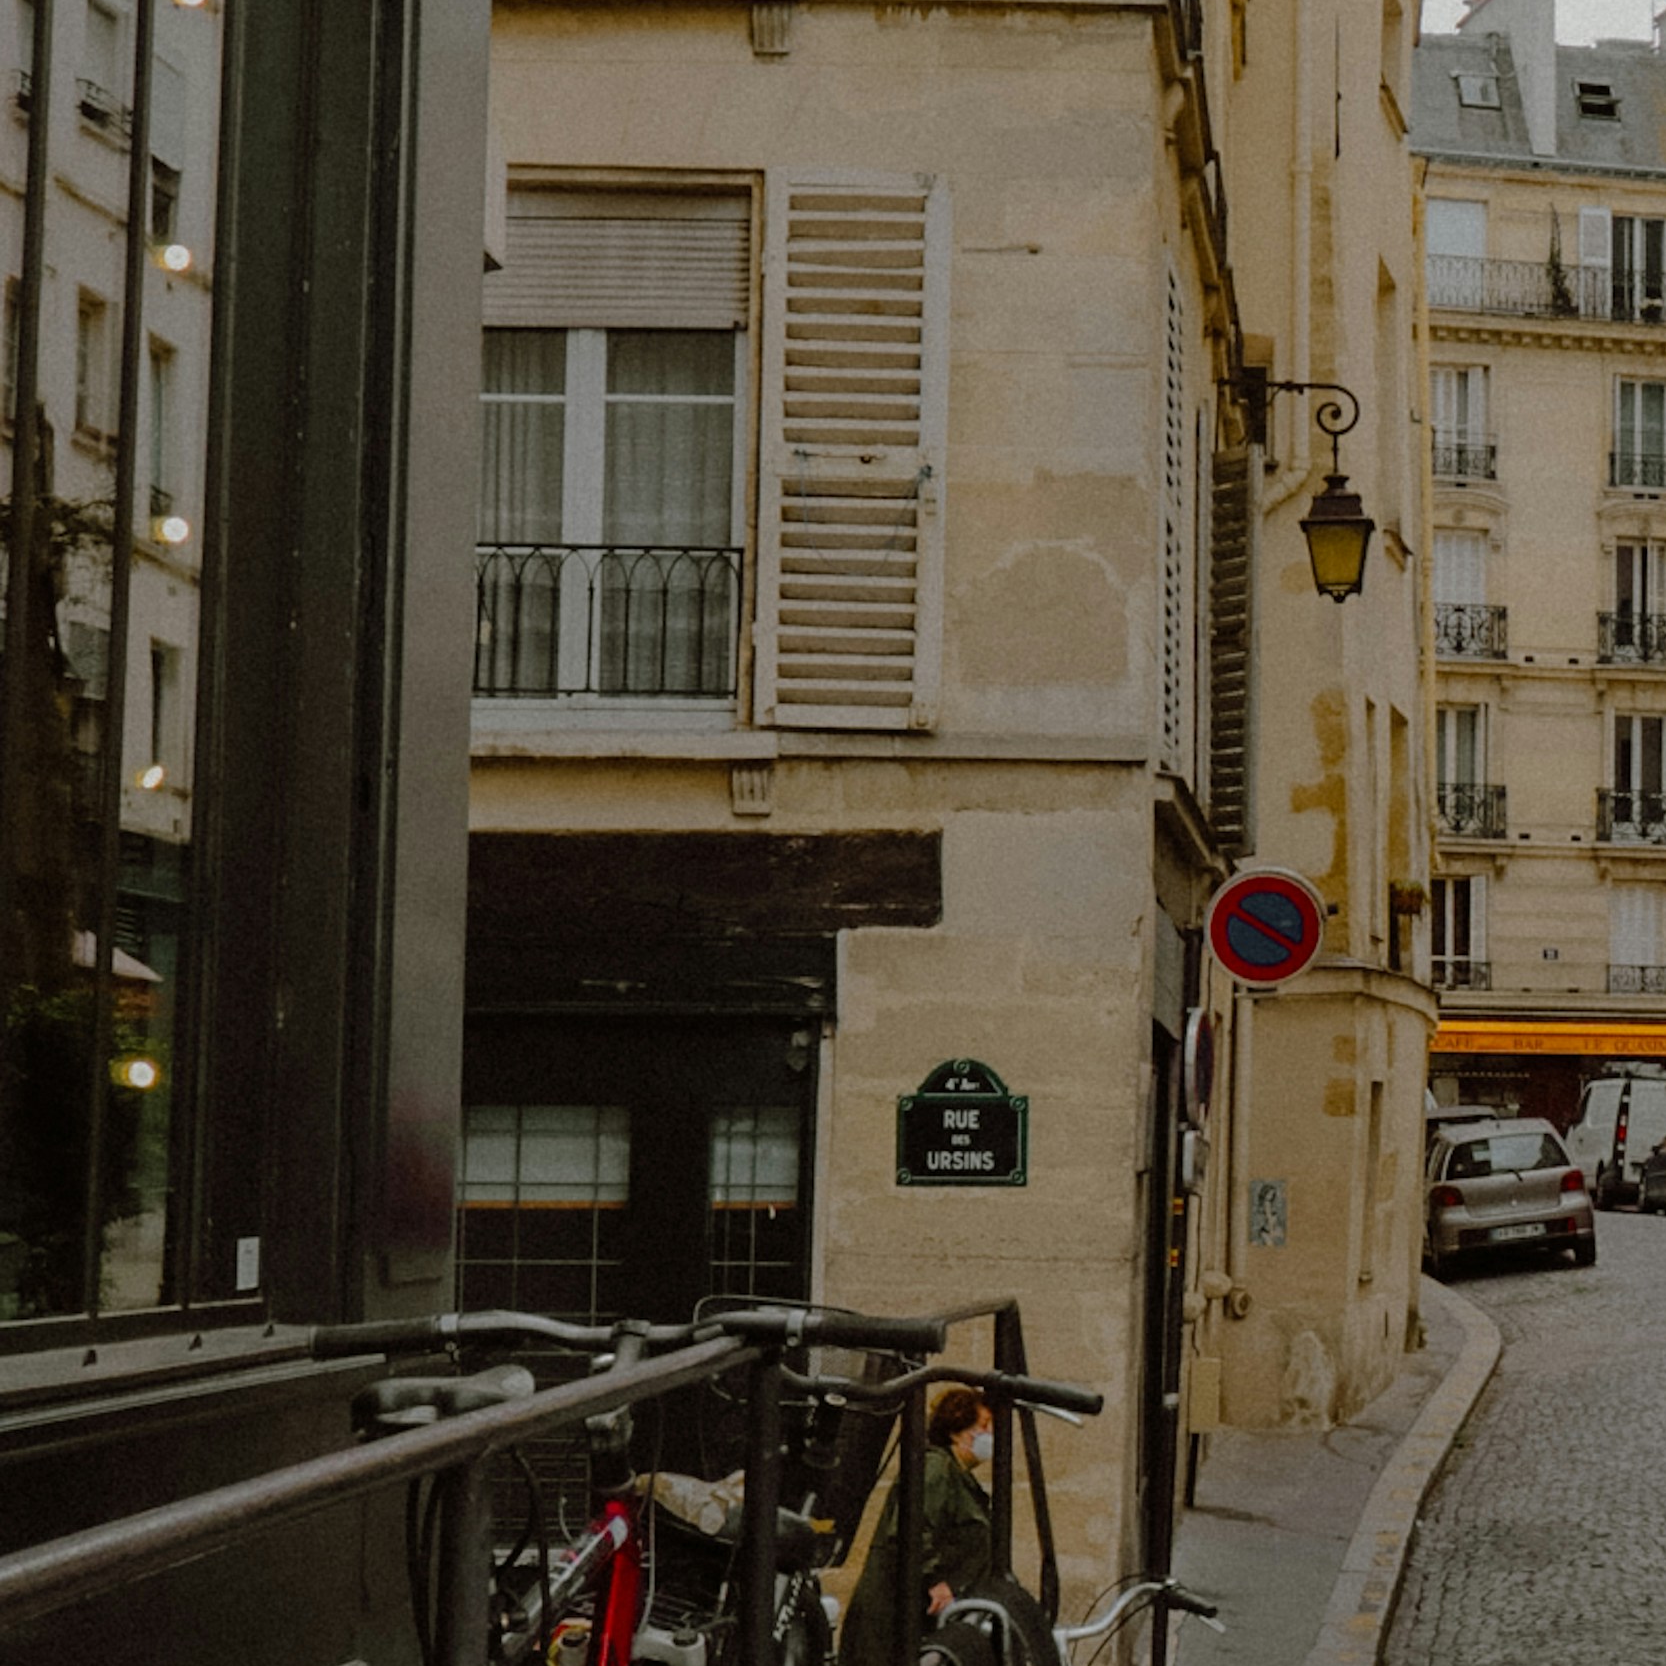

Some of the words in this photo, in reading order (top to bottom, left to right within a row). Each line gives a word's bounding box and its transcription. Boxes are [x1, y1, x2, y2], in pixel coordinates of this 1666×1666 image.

[943, 1109, 980, 1130] RUE
[951, 1133, 971, 1146] DES
[926, 1150, 995, 1171] URSINS
